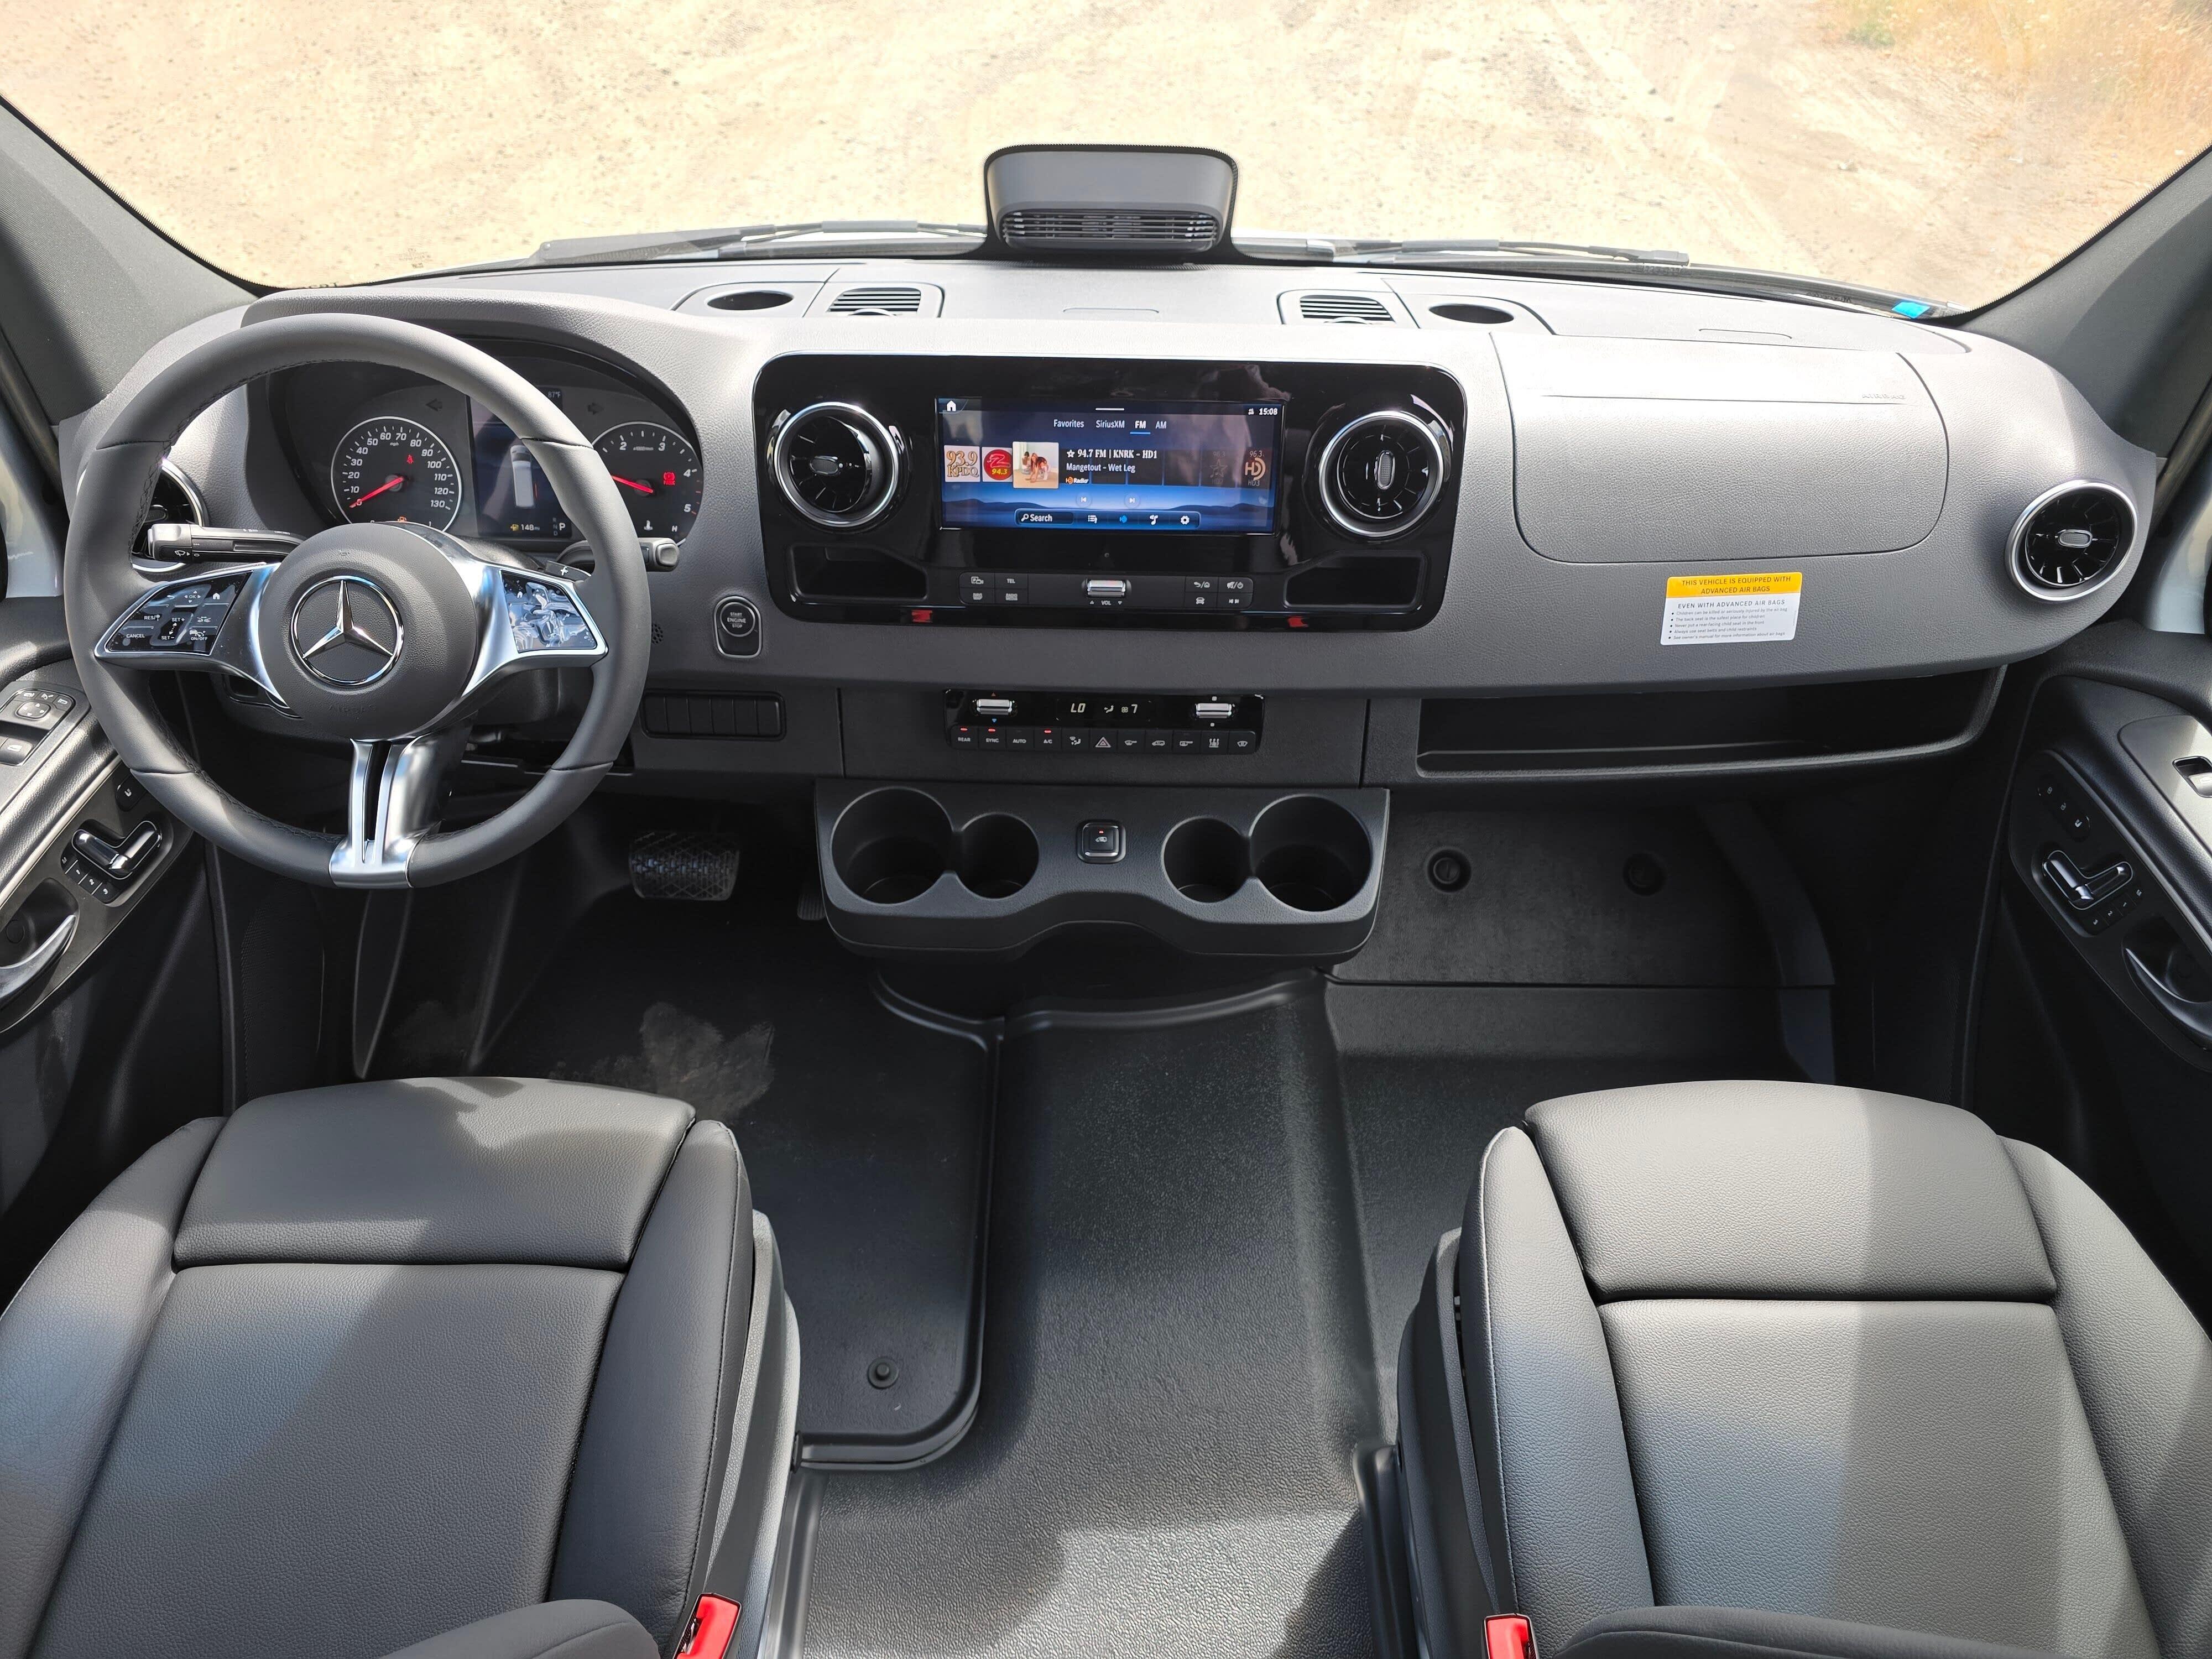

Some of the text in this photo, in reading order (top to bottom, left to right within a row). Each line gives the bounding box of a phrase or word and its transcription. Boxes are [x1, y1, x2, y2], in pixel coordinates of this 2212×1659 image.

[1053, 419, 1084, 428] Favorites
[1095, 420, 1125, 429] SiriusXM
[1135, 420, 1146, 429] FM
[1155, 421, 1167, 429] AM
[395, 432, 406, 441] 70
[410, 439, 421, 447] 80
[619, 441, 627, 450] 2
[659, 442, 666, 451] 3
[1077, 449, 1093, 458] 94.7
[1095, 449, 1106, 458] FM
[1113, 450, 1134, 458] KNRK
[1142, 450, 1157, 458] HD1
[946, 451, 978, 466] 93.9
[684, 468, 691, 477] 4
[947, 465, 979, 477] KPDQ
[1066, 463, 1102, 472] Mangetout
[1124, 464, 1135, 473] Leg
[684, 504, 691, 513] 5
[1030, 514, 1053, 522] Search
[559, 523, 566, 531] P
[1131, 704, 1138, 713] 7
